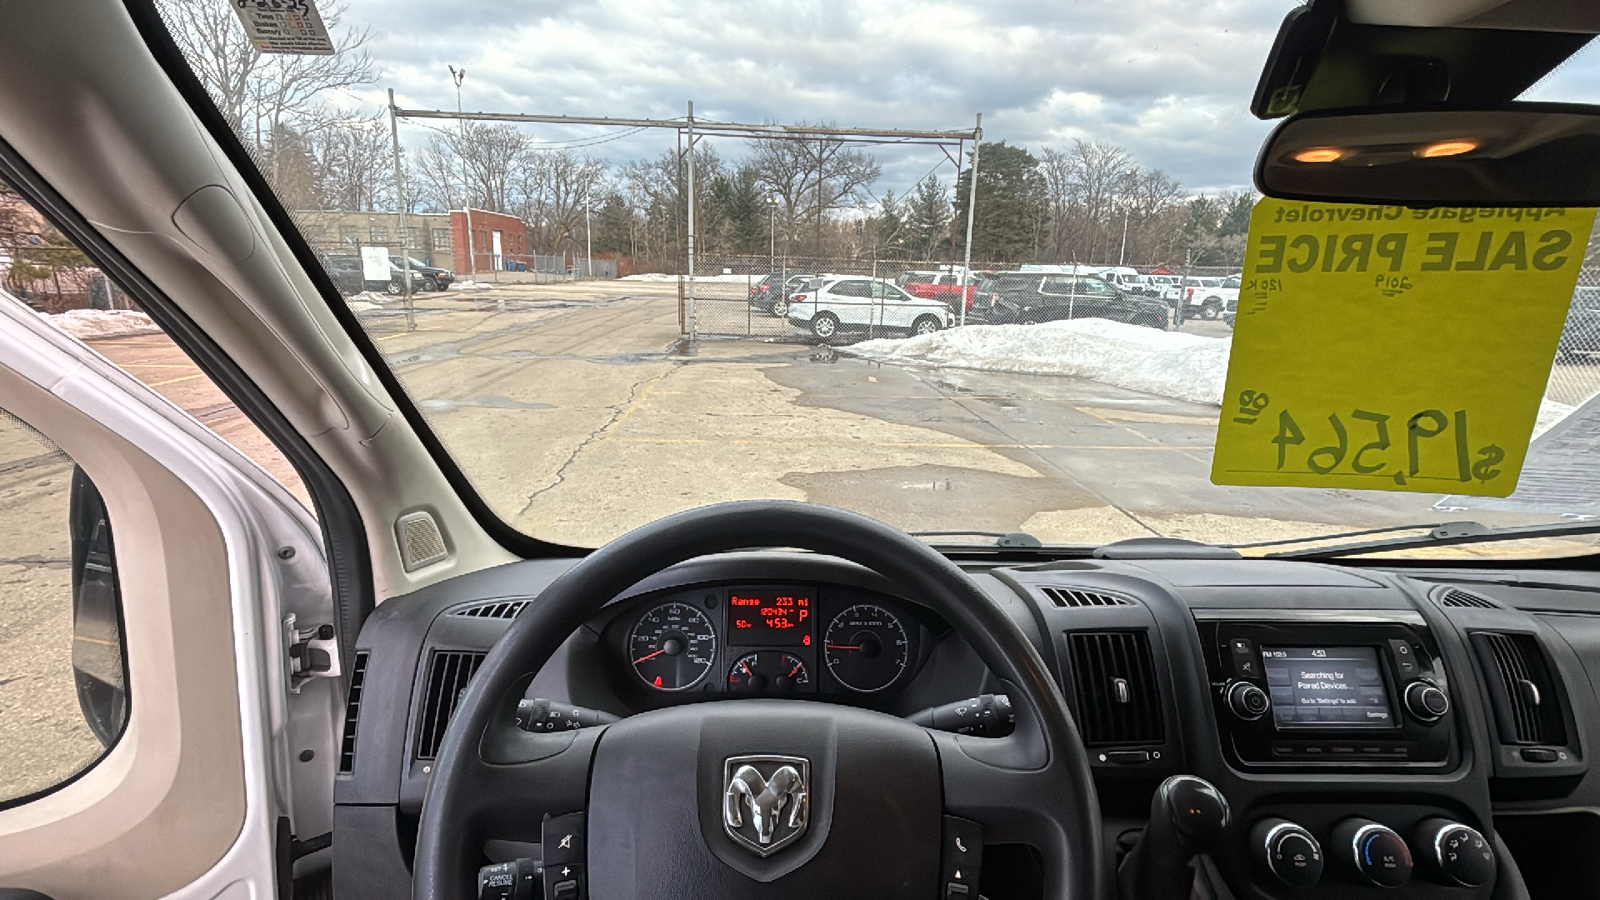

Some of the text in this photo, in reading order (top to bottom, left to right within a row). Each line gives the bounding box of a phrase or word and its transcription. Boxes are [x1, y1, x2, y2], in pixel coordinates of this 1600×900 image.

[732, 596, 809, 606] Range 233 mi
[799, 609, 809, 622] P
[1301, 671, 1344, 681] Searching for
[1297, 681, 1320, 690] Paired
[1366, 711, 1388, 719] Settings
